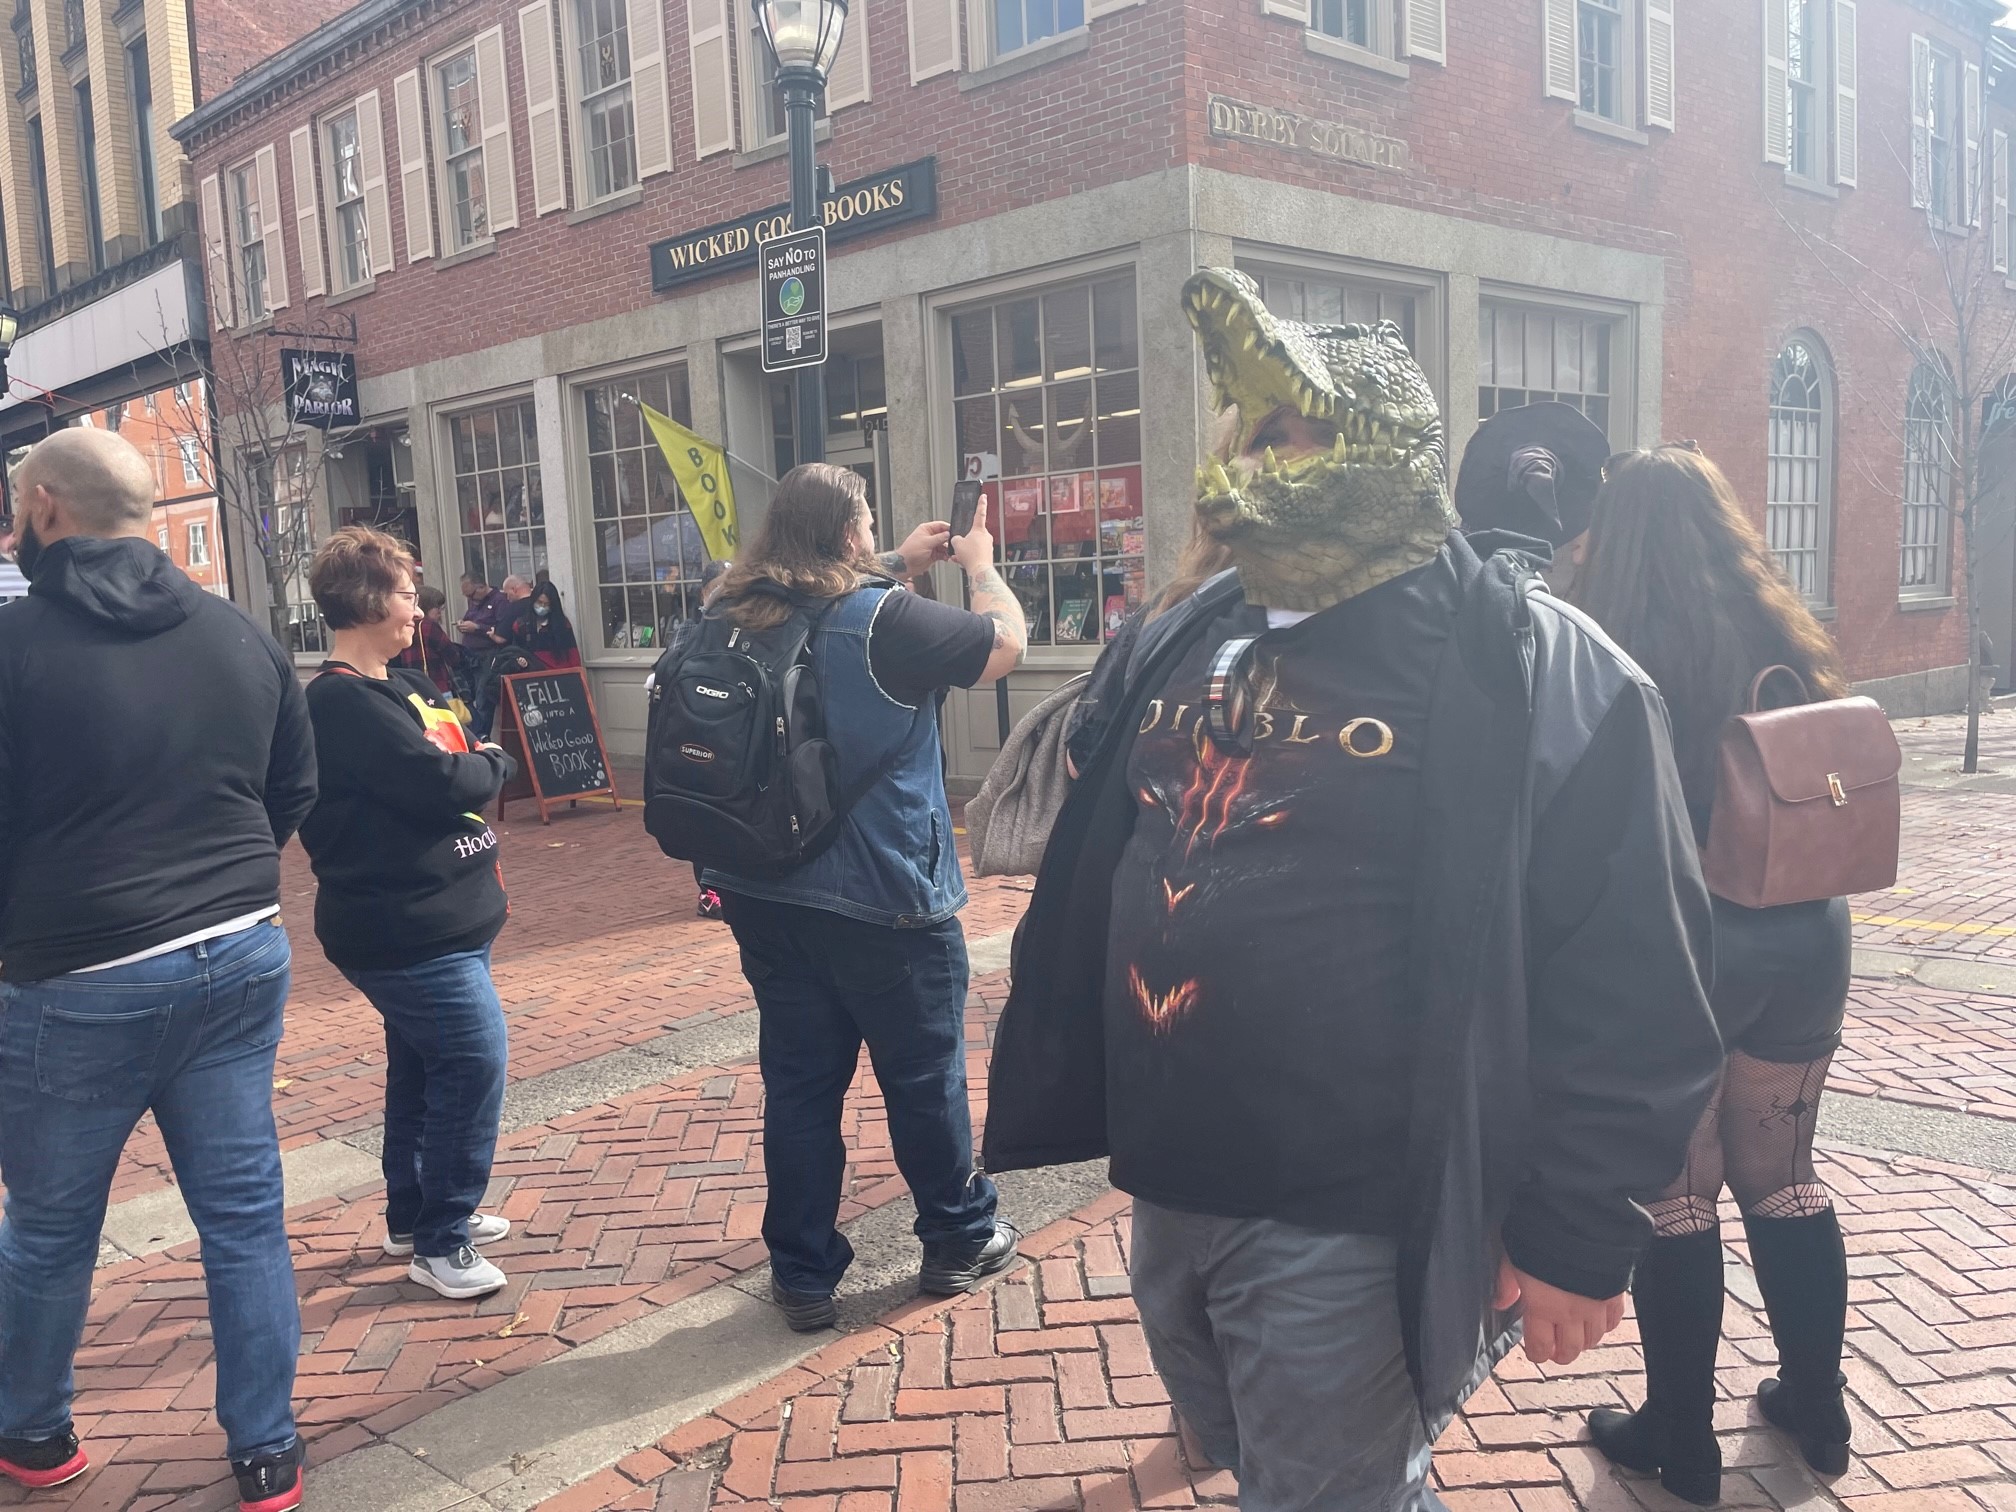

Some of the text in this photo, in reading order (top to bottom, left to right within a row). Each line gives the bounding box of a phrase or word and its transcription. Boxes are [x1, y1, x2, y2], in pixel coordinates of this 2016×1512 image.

[1213, 102, 1302, 147] DERBY
[669, 227, 750, 270] WICKED
[822, 179, 904, 227] BOOKS
[768, 249, 816, 269] SAY NO TO
[769, 263, 815, 281] PANHANDLING
[291, 357, 349, 383] MAGIC
[294, 395, 353, 416] PARLOR
[526, 680, 570, 708] FALL
[695, 685, 730, 699] OGIO
[546, 710, 565, 718] INTO
[681, 746, 713, 760] SUPERIOR
[549, 749, 592, 779] BOOK
